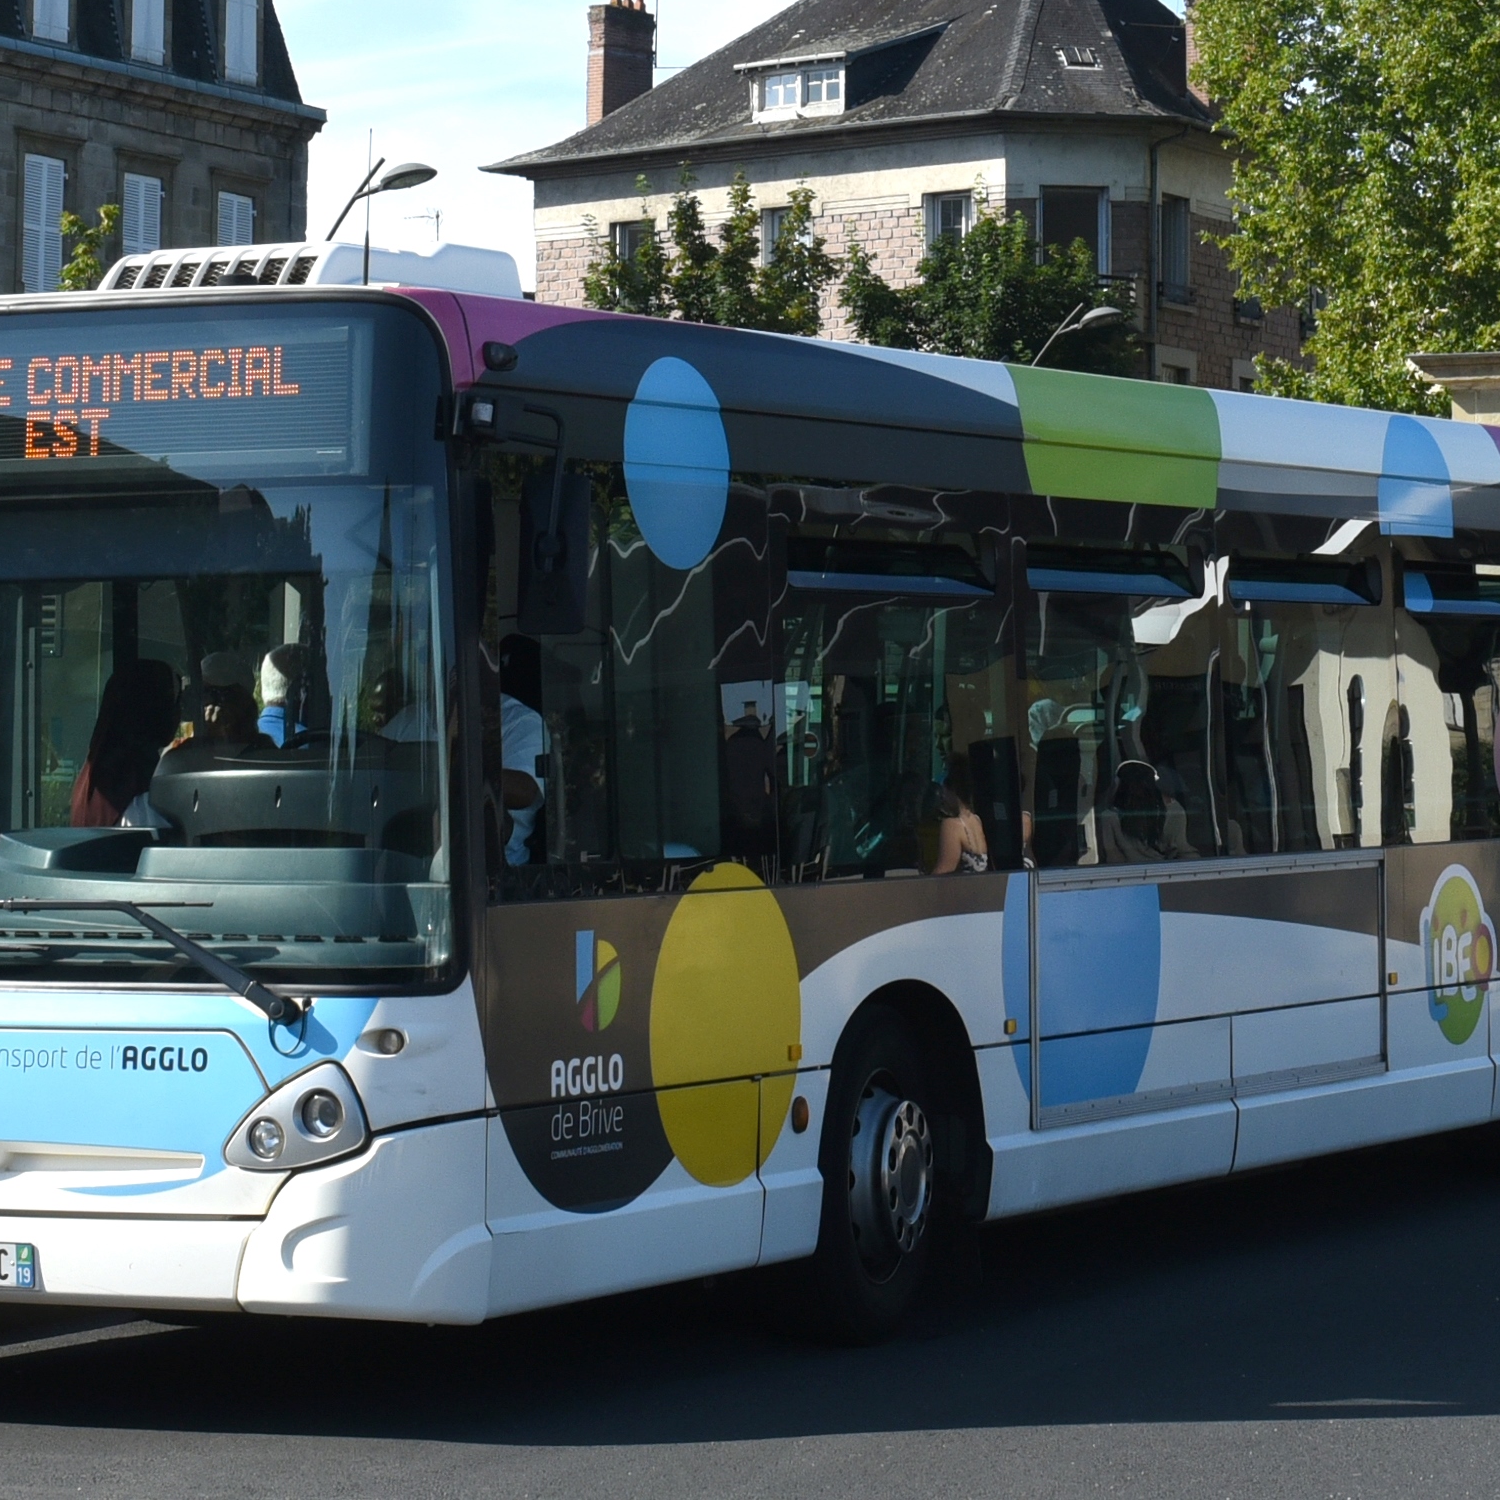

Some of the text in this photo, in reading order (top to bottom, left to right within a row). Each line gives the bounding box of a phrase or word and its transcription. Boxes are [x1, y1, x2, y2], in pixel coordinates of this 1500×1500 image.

[26, 346, 299, 405] COMMERCIAL
[25, 408, 111, 458] EST
[76, 1045, 102, 1070] de
[551, 1053, 624, 1098] AGGLO
[551, 1100, 624, 1141] de Brive
[17, 1267, 31, 1283] 19
